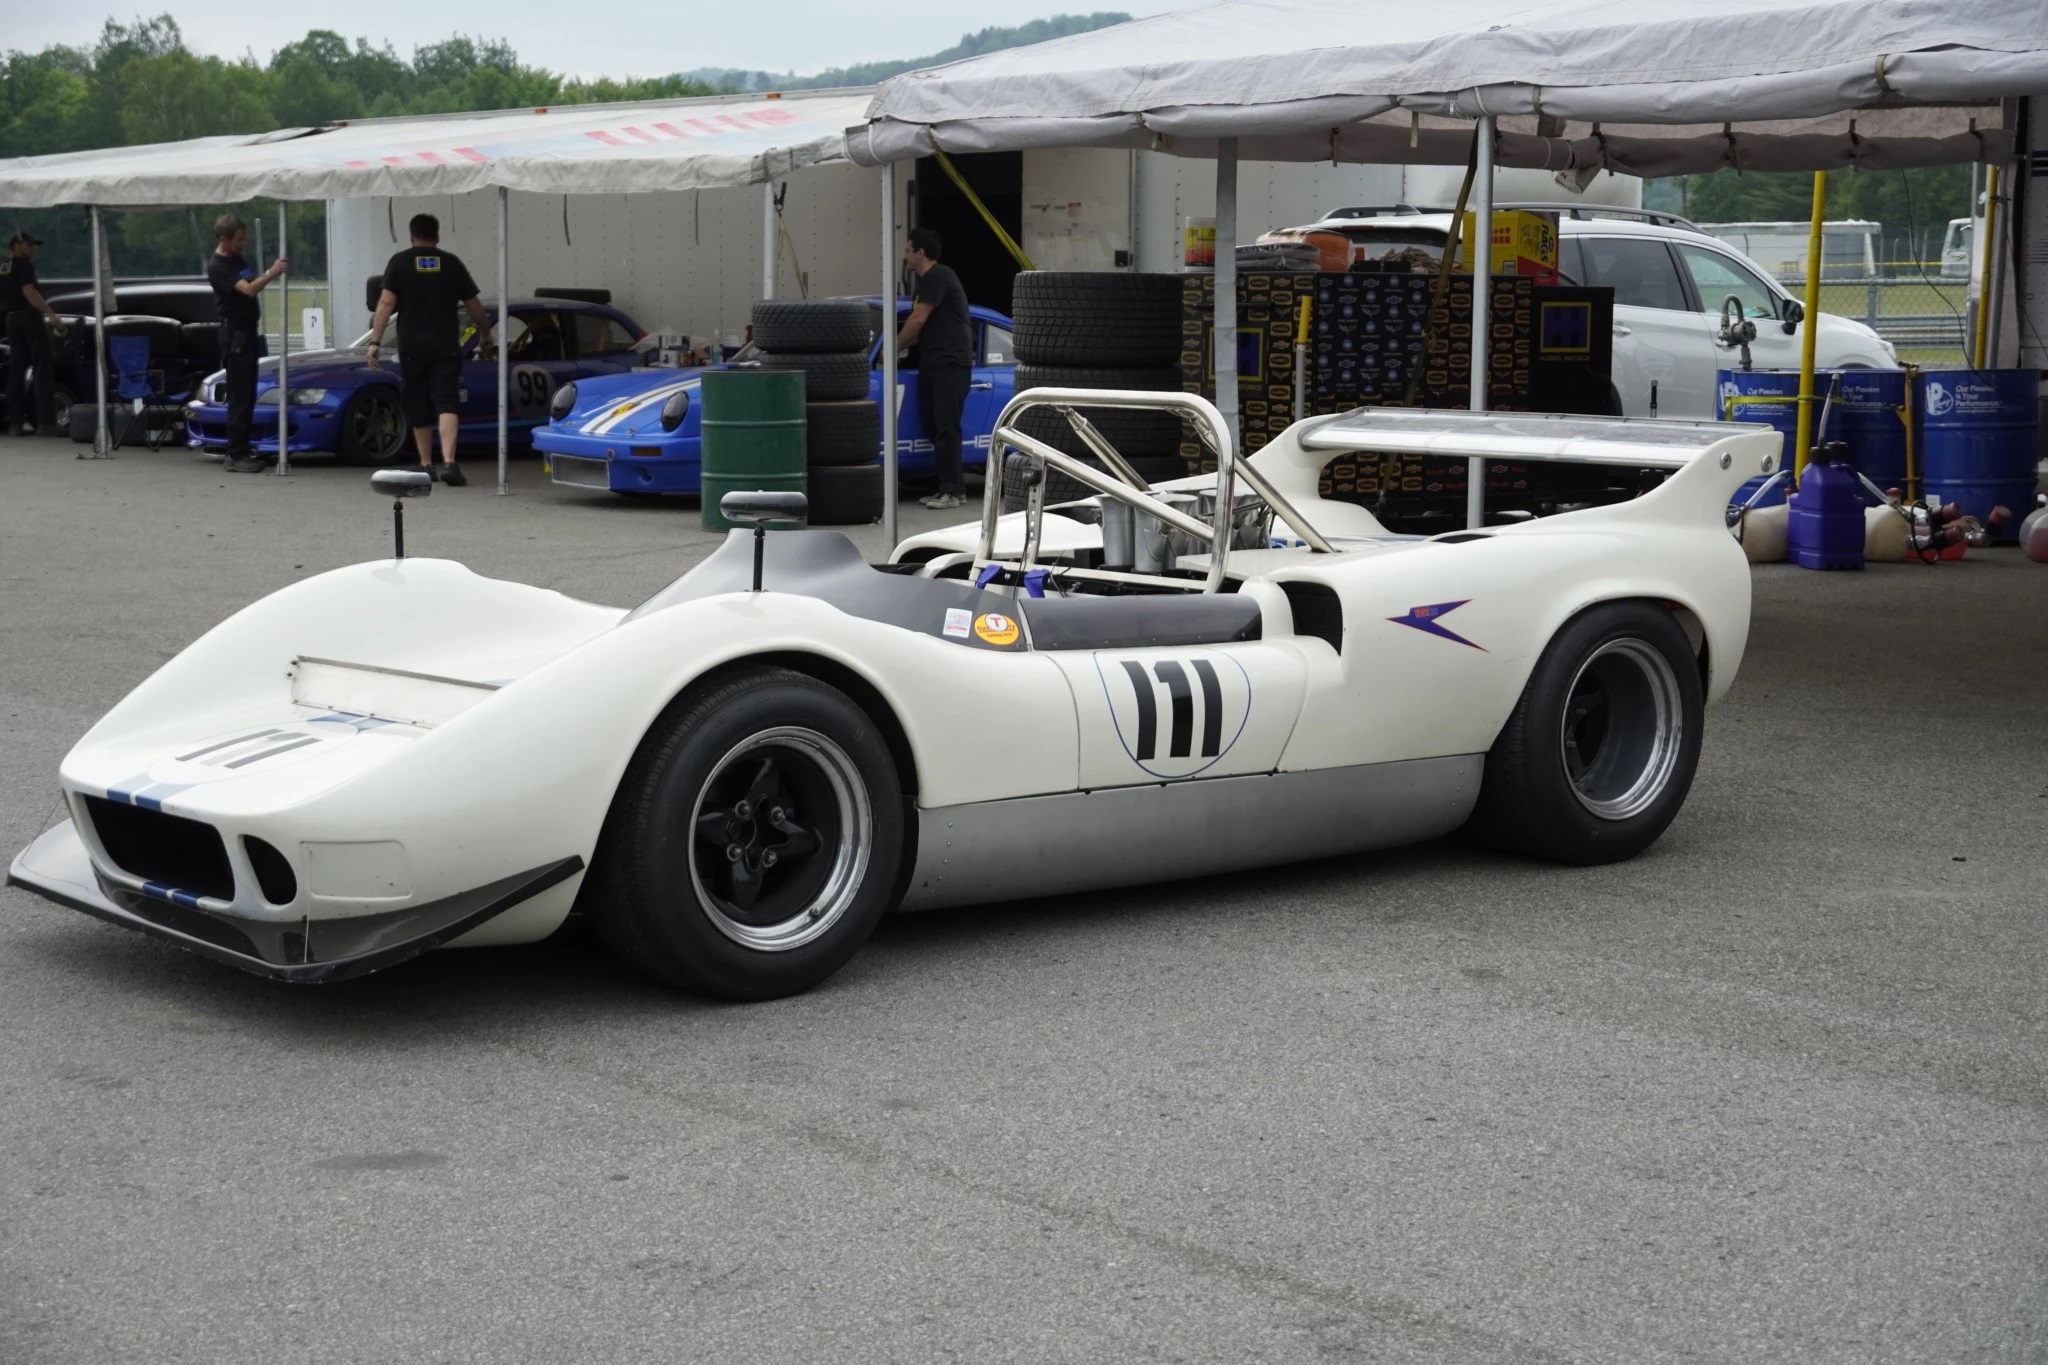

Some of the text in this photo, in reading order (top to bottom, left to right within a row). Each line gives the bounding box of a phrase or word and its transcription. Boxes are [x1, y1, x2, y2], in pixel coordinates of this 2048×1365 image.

[1541, 224, 1549, 264] RAGS
[518, 371, 548, 407] 99
[1855, 385, 1880, 393] Passion
[1120, 659, 1222, 760] 111
